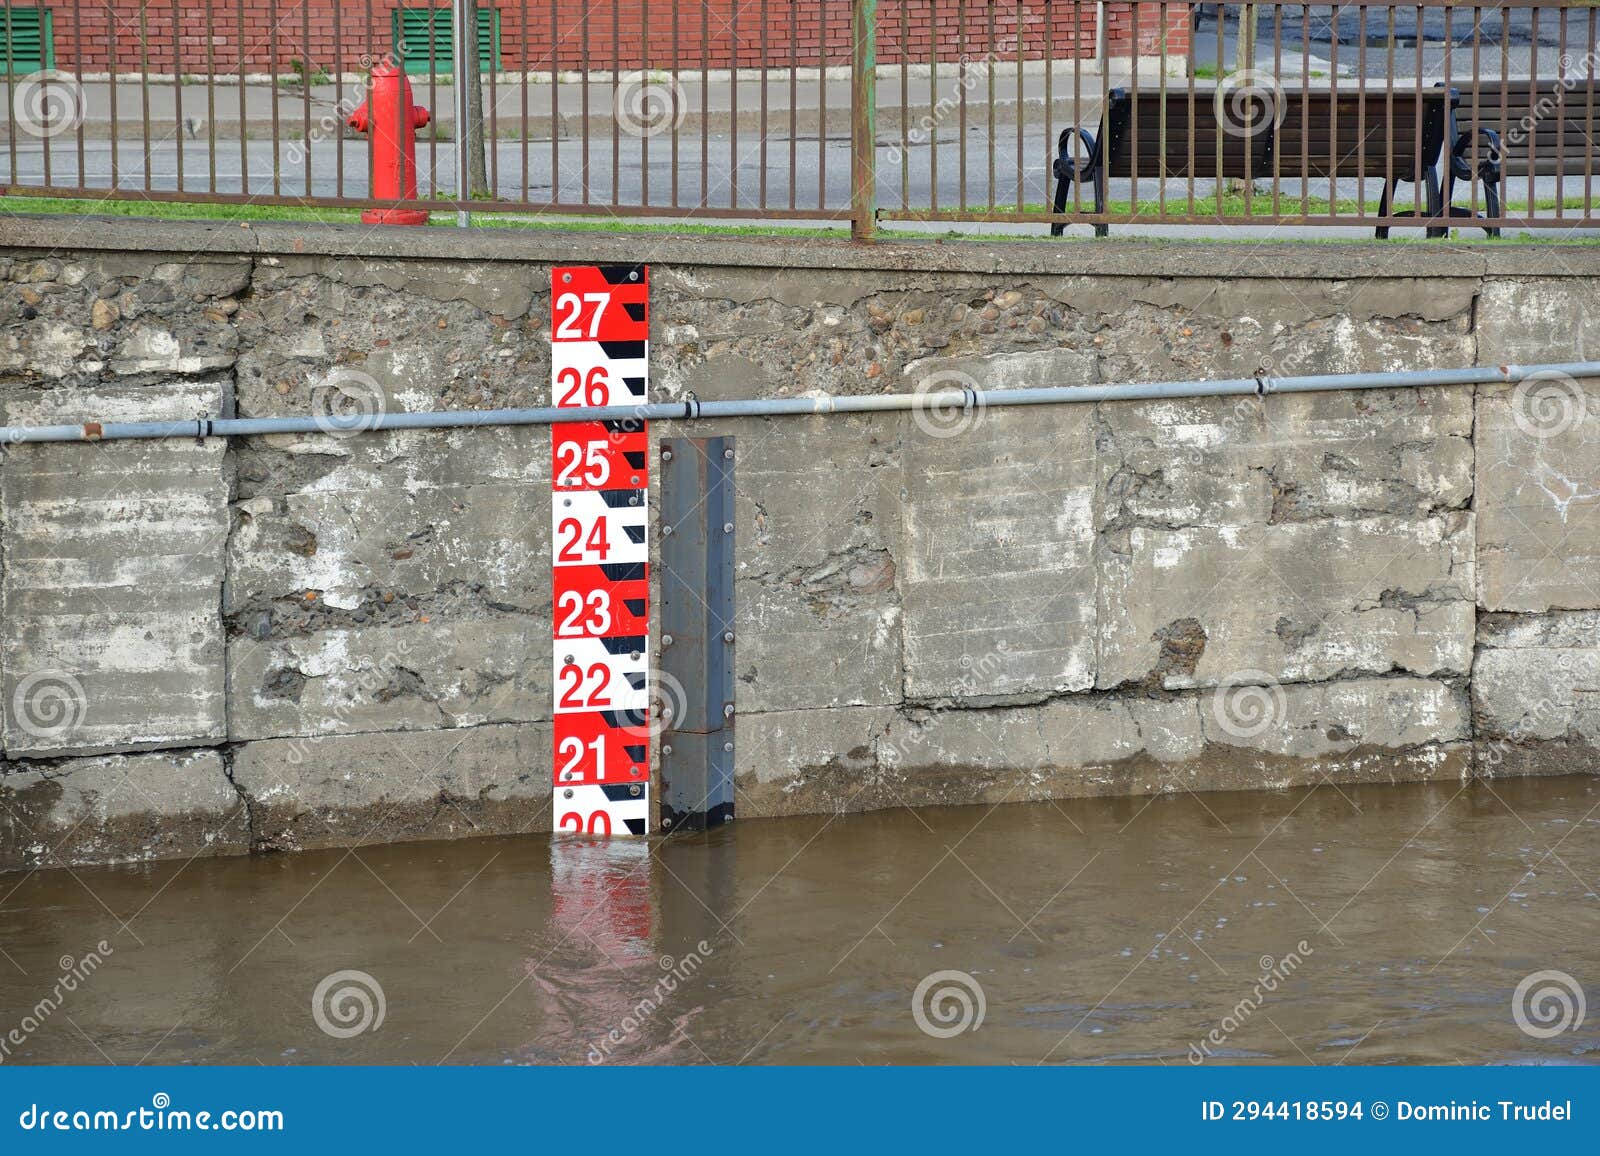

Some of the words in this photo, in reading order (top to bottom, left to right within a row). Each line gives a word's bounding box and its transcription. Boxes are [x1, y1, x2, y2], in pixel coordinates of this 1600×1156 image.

[557, 292, 611, 339] 27
[557, 366, 610, 408] 26
[556, 440, 610, 487] 25
[558, 516, 611, 562] 24
[558, 589, 611, 636] 23
[559, 663, 611, 708] 22
[559, 735, 605, 782] 21
